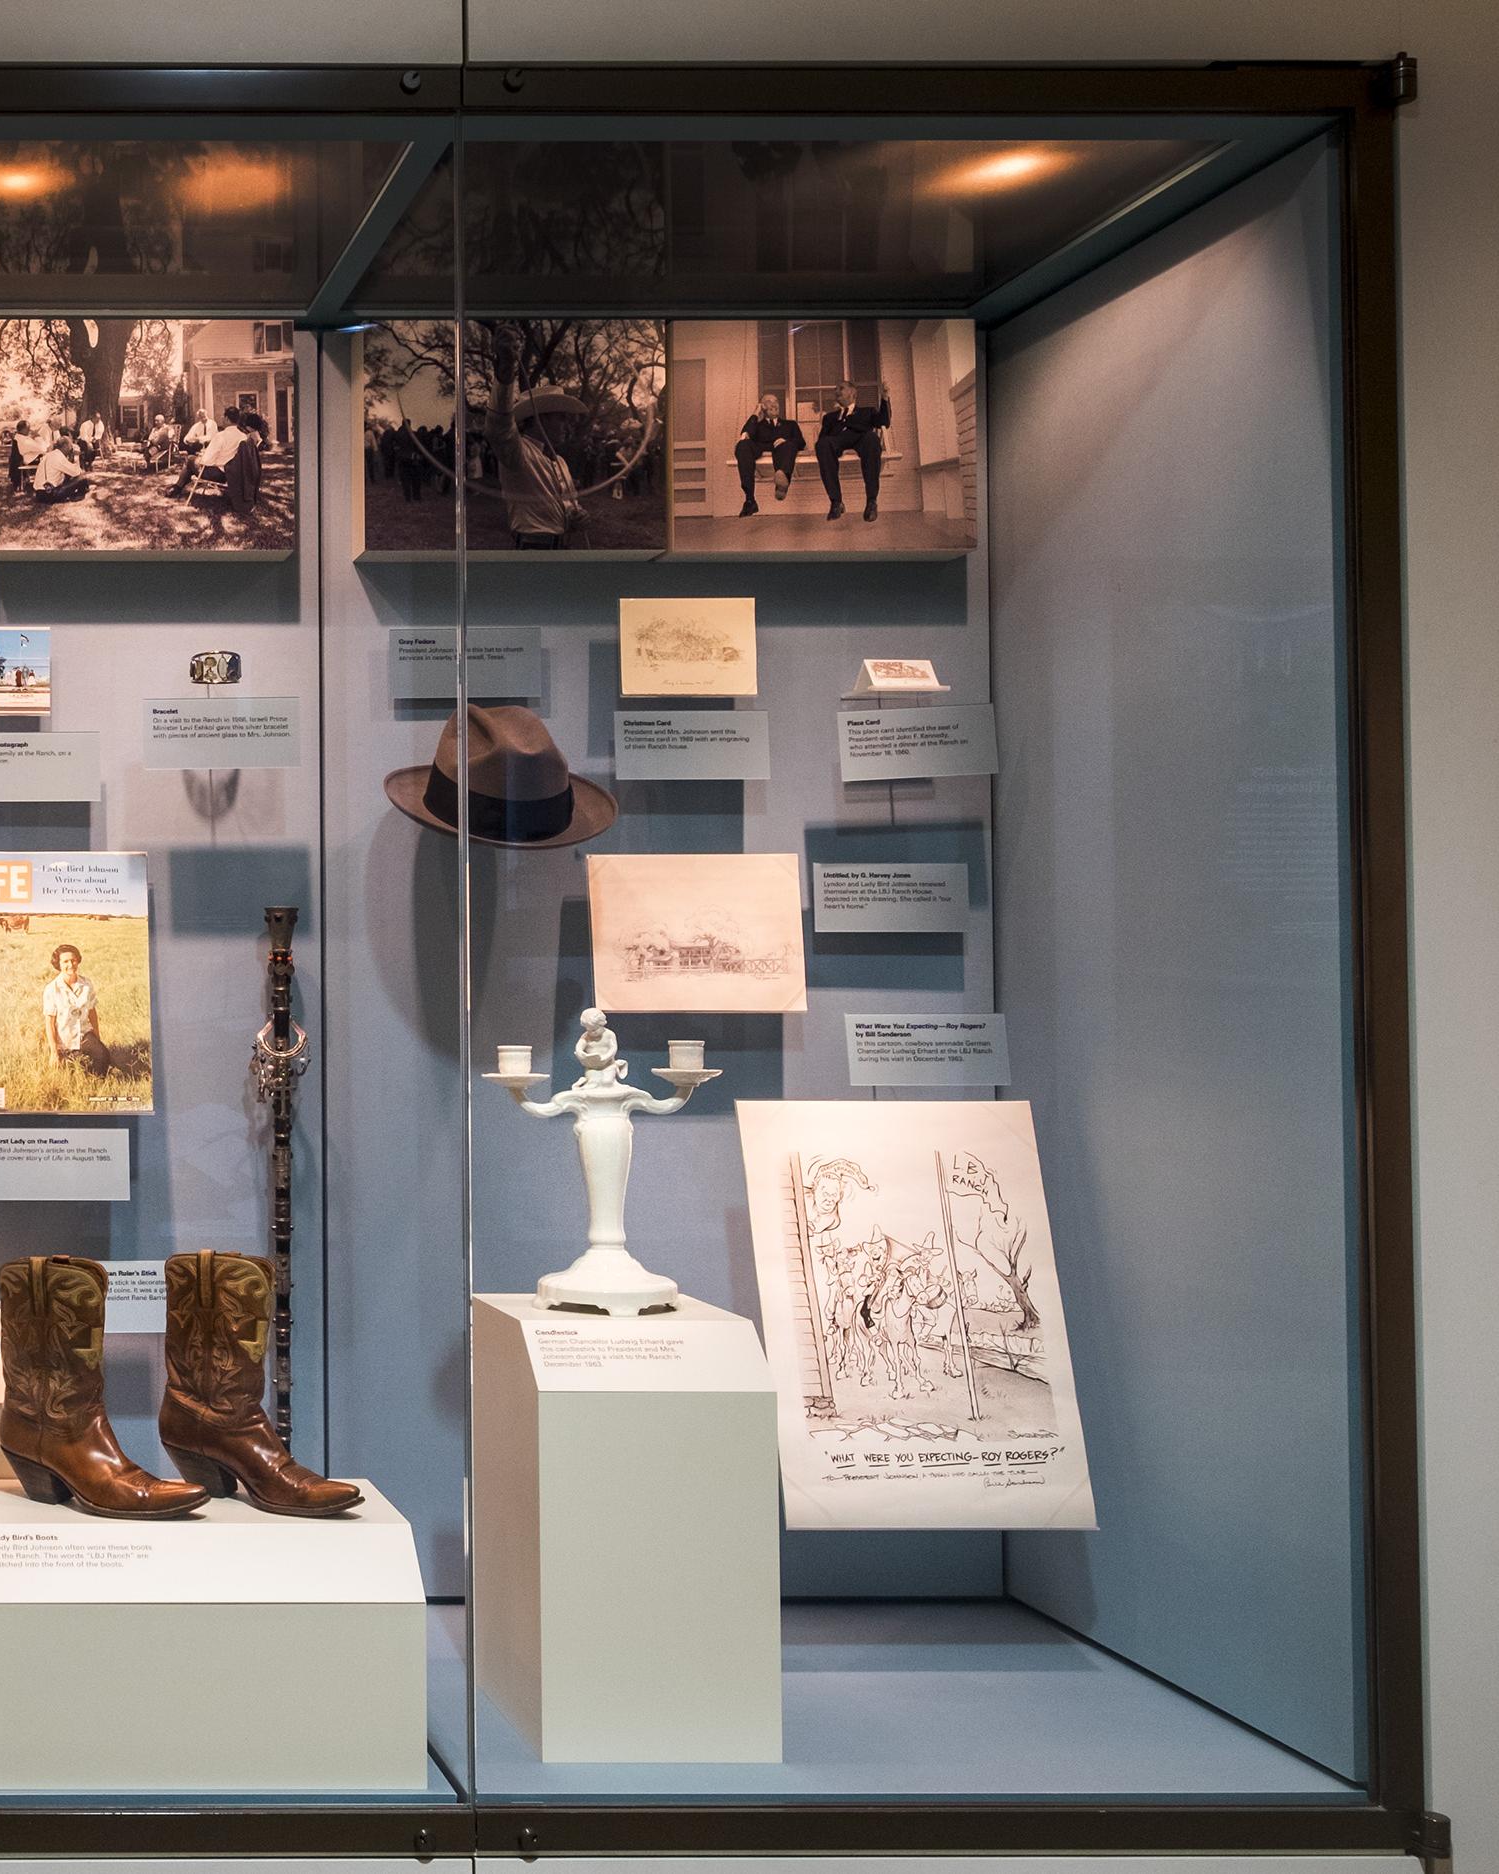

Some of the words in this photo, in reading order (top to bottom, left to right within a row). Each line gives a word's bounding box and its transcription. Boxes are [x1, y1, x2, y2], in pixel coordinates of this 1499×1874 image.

[42, 865, 61, 874] Lady
[88, 865, 118, 873] Johnson
[55, 876, 81, 884] Writes
[85, 876, 107, 884] about
[62, 887, 91, 895] Private
[960, 1023, 986, 1031] Rogers?
[11, 1138, 25, 1146] Lady
[952, 1175, 989, 1197] RANCH
[864, 1453, 890, 1462] WERE
[896, 1453, 914, 1463] YOU
